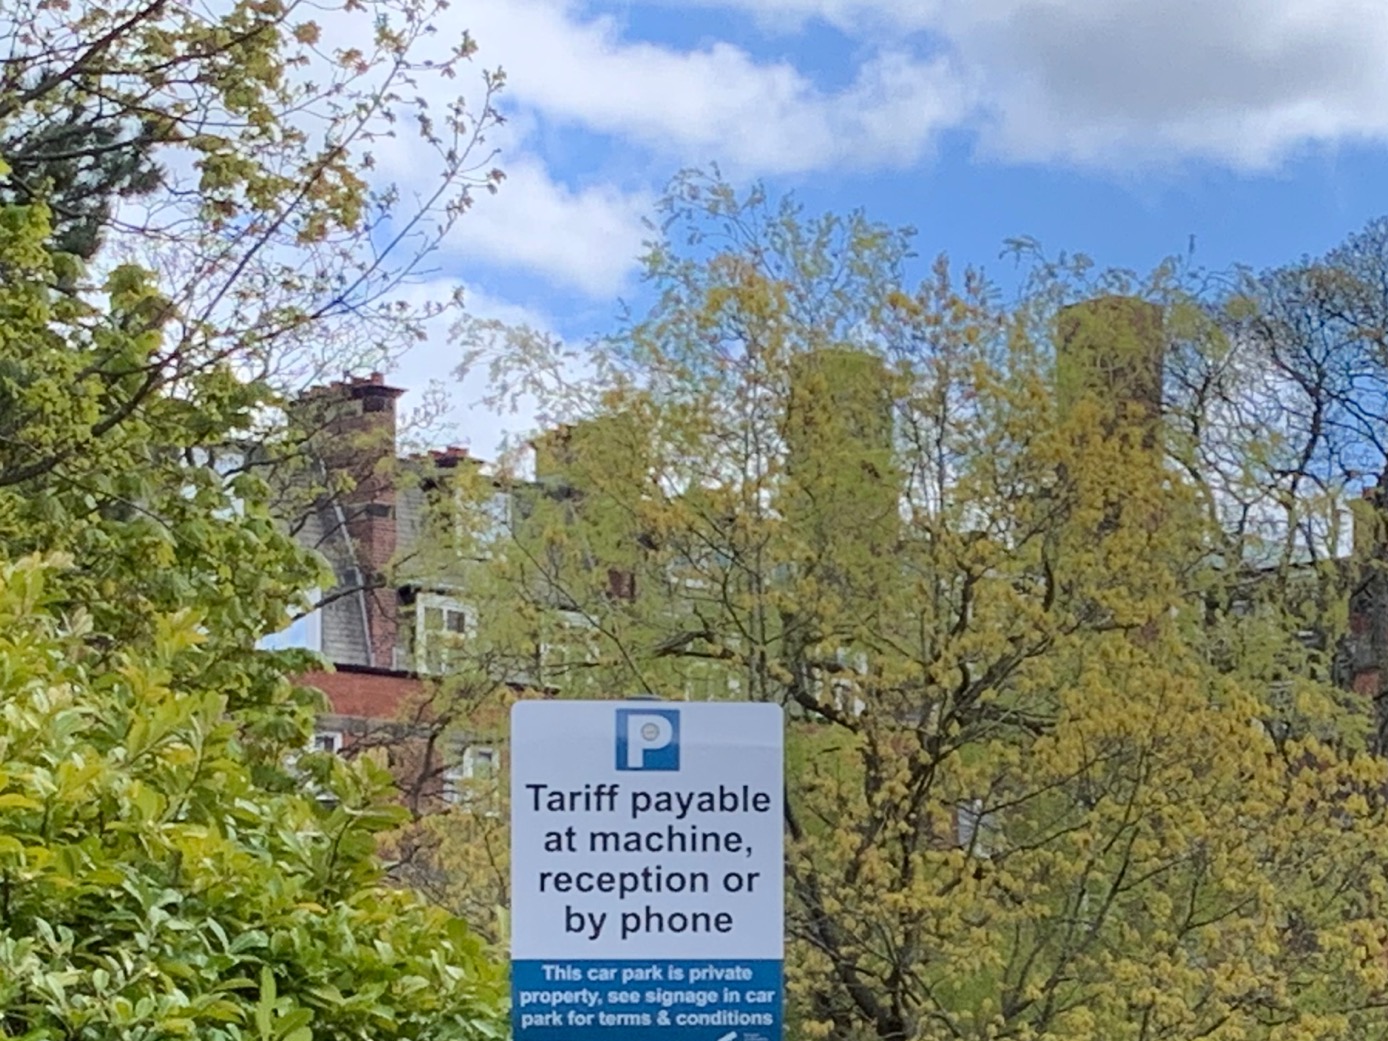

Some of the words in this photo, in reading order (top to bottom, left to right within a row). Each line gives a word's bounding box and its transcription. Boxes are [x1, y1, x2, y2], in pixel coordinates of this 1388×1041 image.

[627, 714, 673, 768] P
[525, 783, 620, 812] Tariff
[631, 785, 771, 819] payable
[544, 827, 577, 853] at
[590, 825, 752, 857] machine,
[539, 865, 709, 900] reception
[723, 871, 760, 892] or
[565, 905, 607, 940] by
[621, 905, 733, 939] phone
[541, 964, 583, 981] This
[587, 967, 617, 981] car
[622, 964, 664, 984] park
[668, 964, 685, 981] is
[689, 964, 753, 984] private
[519, 988, 603, 1007] property,
[607, 990, 640, 1004] see
[645, 987, 718, 1007] signage
[723, 987, 741, 1004] in
[745, 989, 776, 1004] car
[521, 1011, 563, 1029] park
[567, 1010, 595, 1026] for
[598, 1011, 651, 1027] terms
[656, 1011, 672, 1026] &
[676, 1010, 773, 1027] conditions
